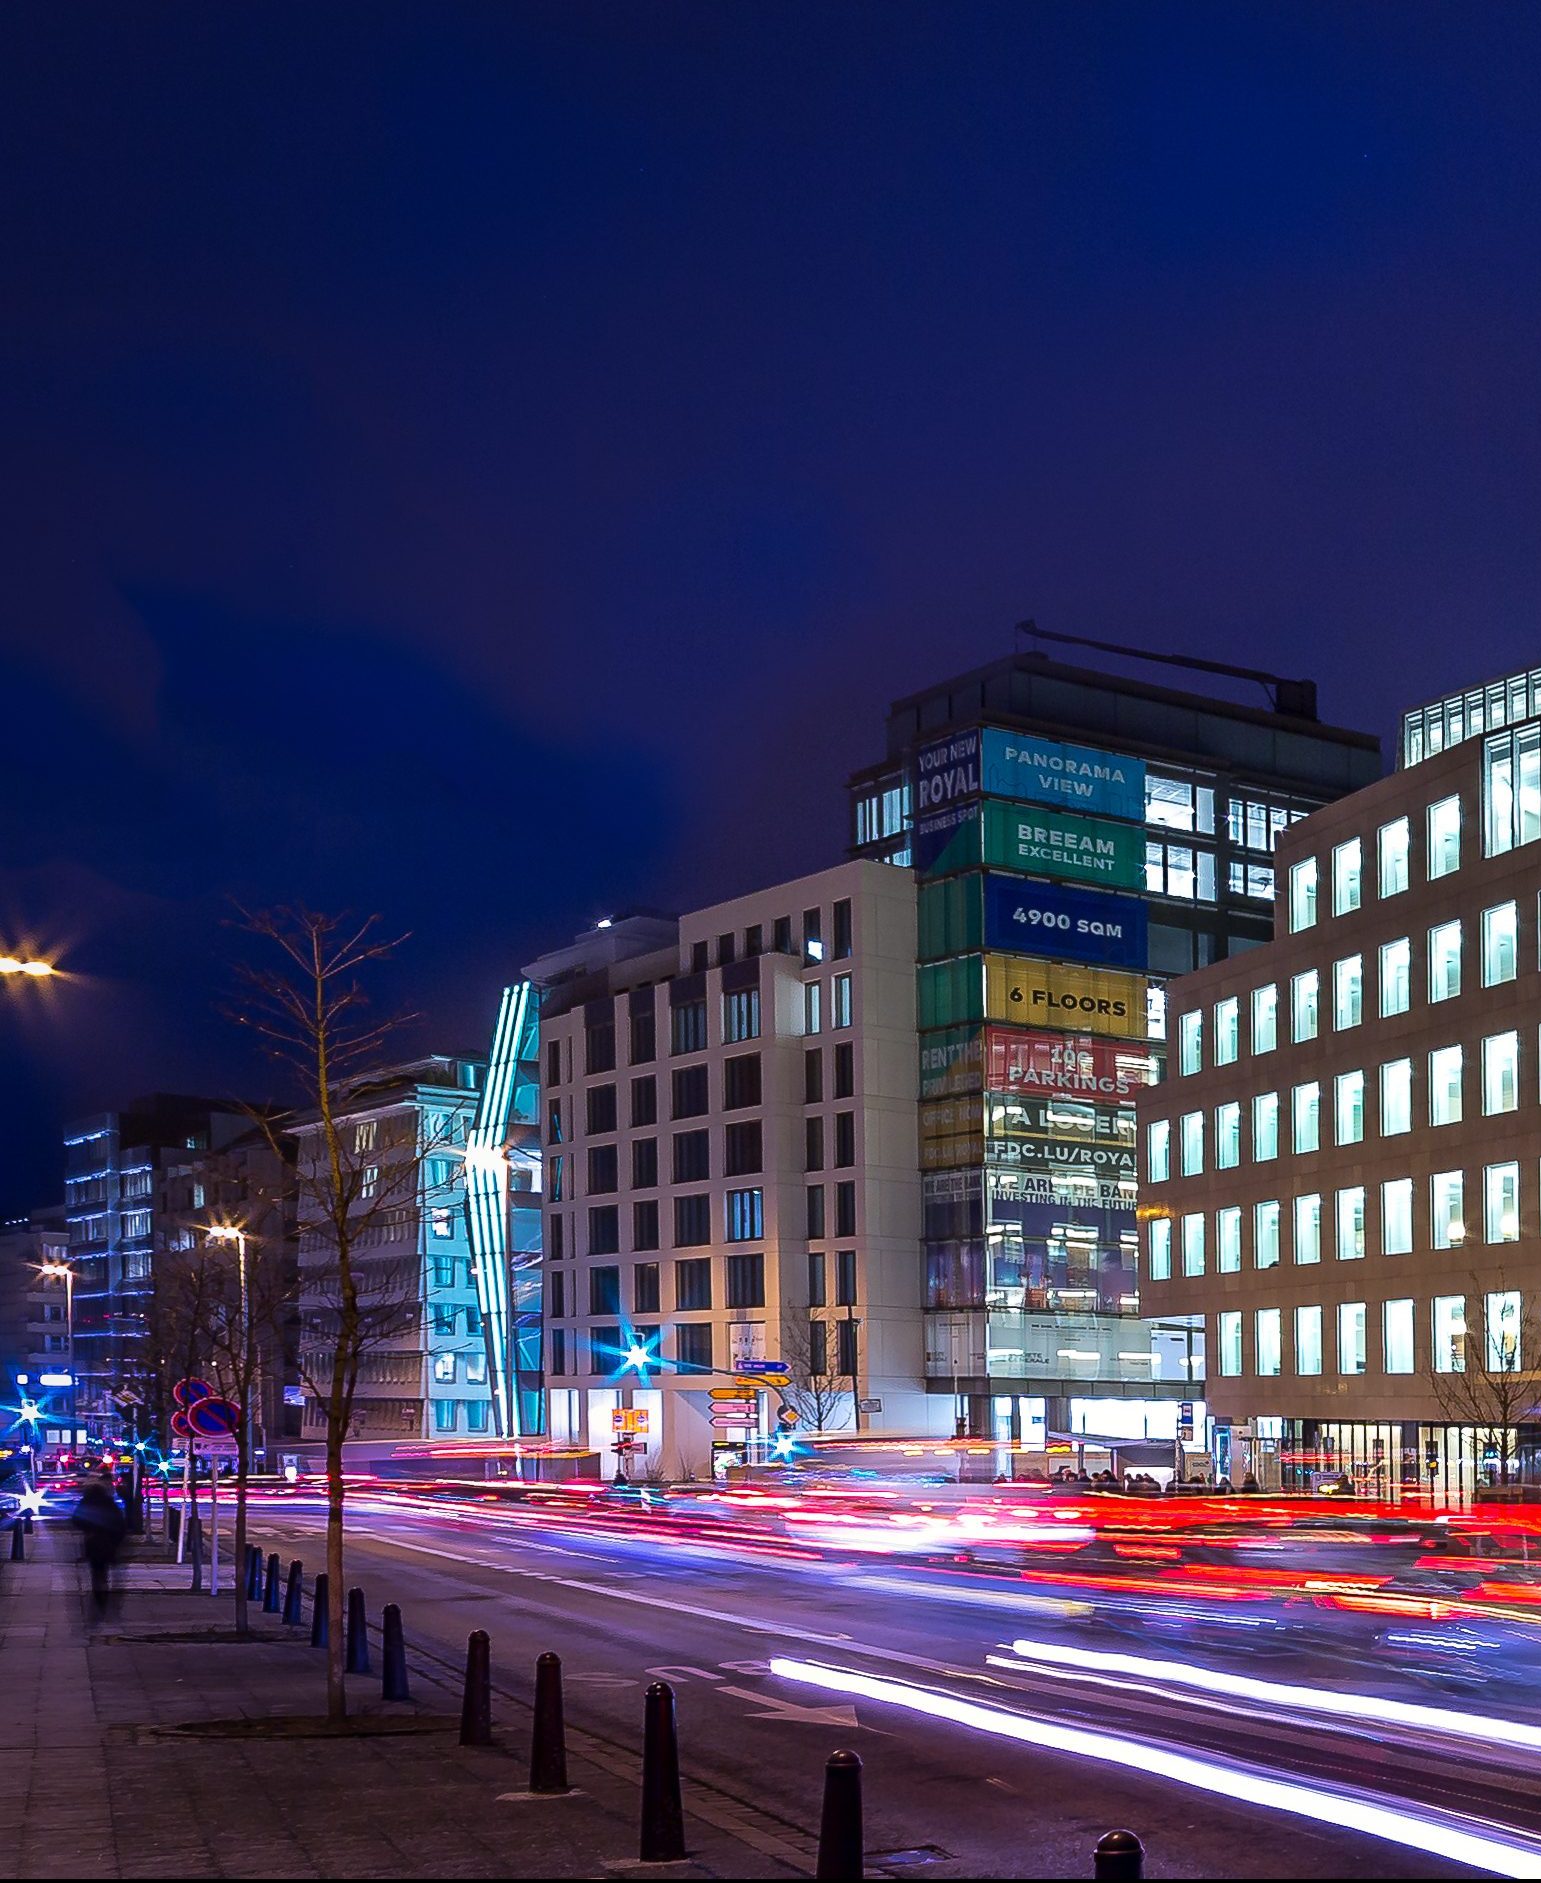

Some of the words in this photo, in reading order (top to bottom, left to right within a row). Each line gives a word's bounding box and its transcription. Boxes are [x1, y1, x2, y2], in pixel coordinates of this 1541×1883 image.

[919, 747, 947, 772] YOUR
[950, 736, 977, 761] NEW
[1005, 746, 1125, 784] PANORAMA
[919, 763, 978, 809] ROYAL
[1039, 774, 1093, 797] VIEW
[919, 812, 956, 835] BUSINESS
[957, 805, 978, 823] SPOT
[1018, 824, 1115, 856] BREEAM
[1018, 844, 1115, 871] EXCELLENT
[1012, 907, 1070, 930] 4900
[1077, 919, 1122, 938] SQM
[1009, 986, 1023, 1003] 6
[1032, 989, 1126, 1017] FLOORS
[921, 1044, 955, 1071] RENT
[1009, 1065, 1130, 1094] PARKINGS
[993, 1141, 1136, 1167] FDC.LU/ROYA
[992, 1189, 1055, 1205] INVESTING
[1103, 1199, 1137, 1211] FUTUR
[1101, 1183, 1136, 1200] BAN
